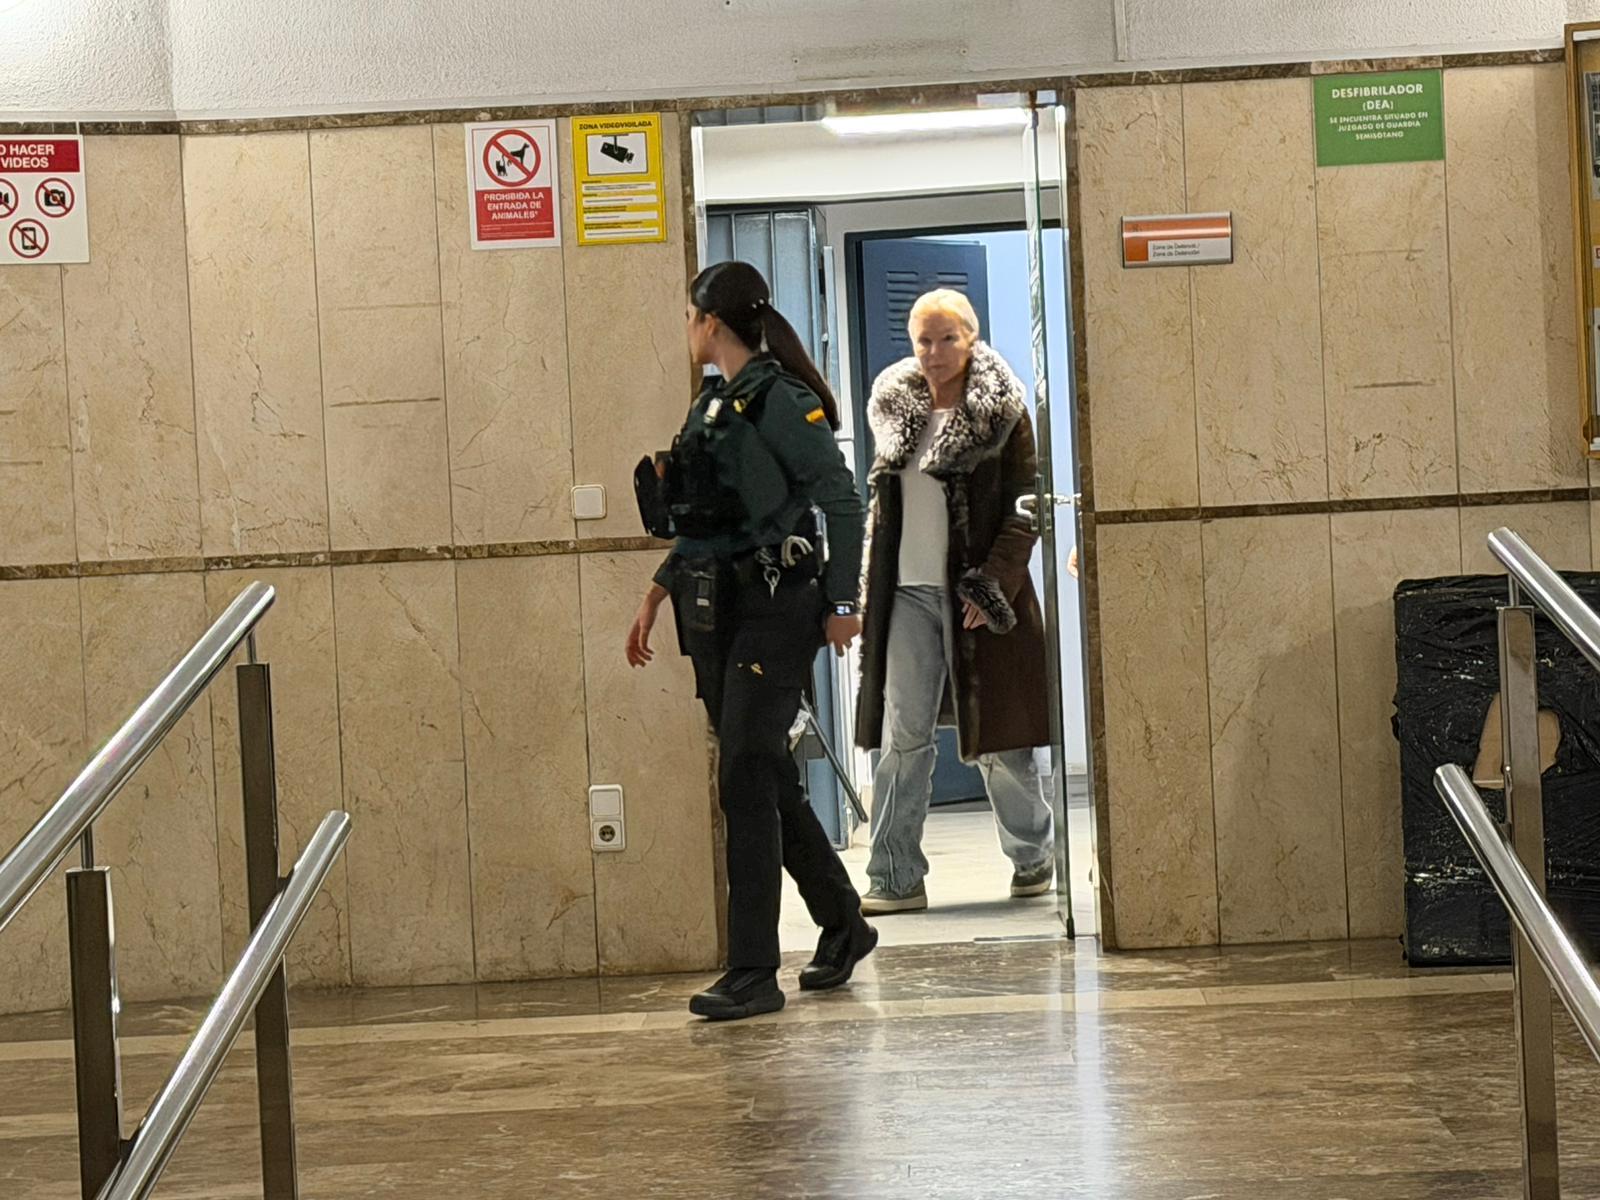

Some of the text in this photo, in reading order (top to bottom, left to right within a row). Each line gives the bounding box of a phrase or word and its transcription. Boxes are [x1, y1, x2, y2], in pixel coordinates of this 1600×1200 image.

[1332, 83, 1423, 98] DESFIBRILADOR
[1362, 100, 1394, 111] (DEA)
[1340, 114, 1382, 122] ENCUENTRA
[1384, 112, 1416, 120] SITUADO
[599, 120, 652, 129] VIDEOVIGILADA
[1338, 123, 1374, 132] JUZGADO
[1355, 131, 1404, 140] SEMISOTANO
[10, 144, 55, 156] HACER
[1, 157, 49, 168] VIDEOS
[484, 192, 530, 201] PROHIBIDA
[487, 200, 542, 211] ENTRADA DE
